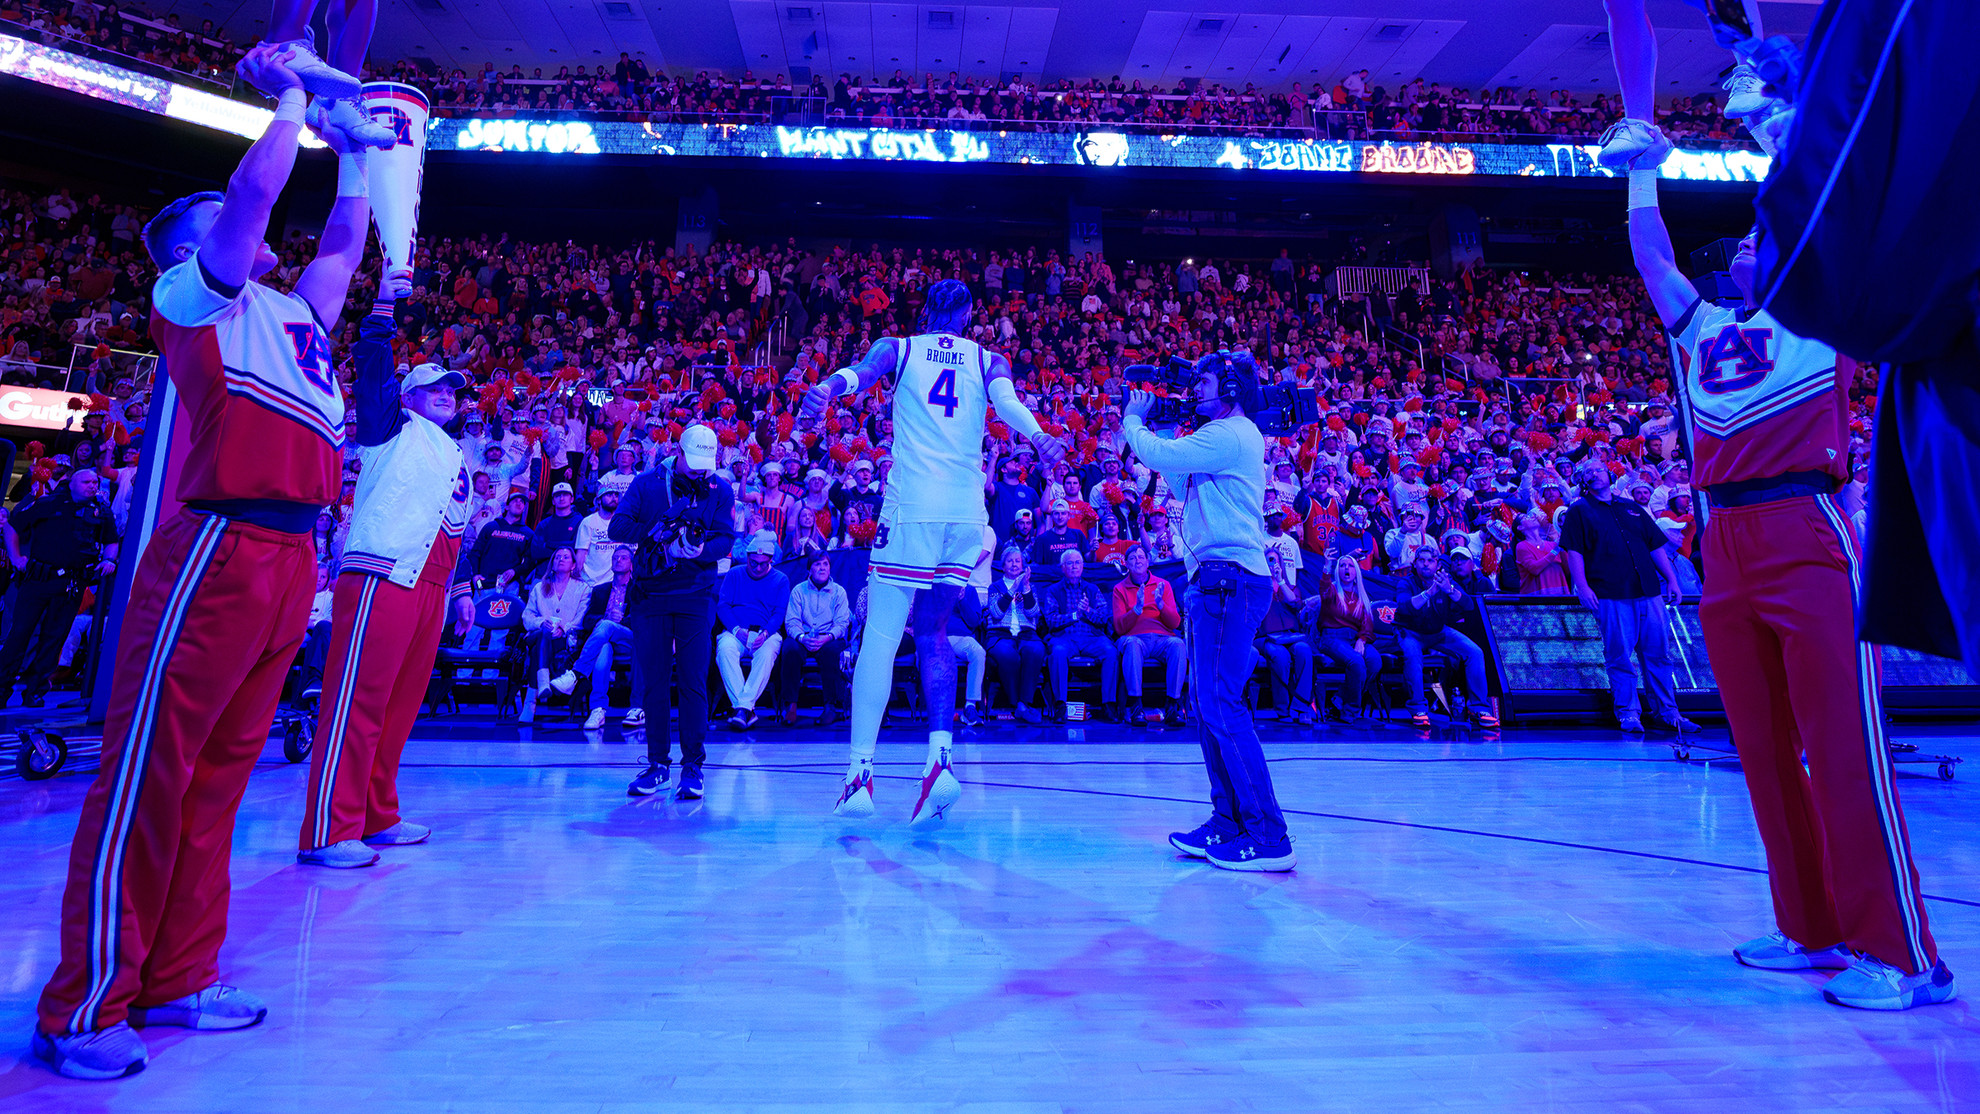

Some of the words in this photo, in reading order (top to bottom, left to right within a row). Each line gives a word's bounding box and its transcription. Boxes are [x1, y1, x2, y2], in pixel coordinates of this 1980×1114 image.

[133, 81, 157, 101] by
[184, 96, 261, 126] YellaWood
[1361, 145, 1475, 174] BROOME
[683, 215, 706, 228] 113
[1075, 222, 1098, 236] 112
[926, 348, 965, 365] BROOME
[927, 368, 959, 418] 4
